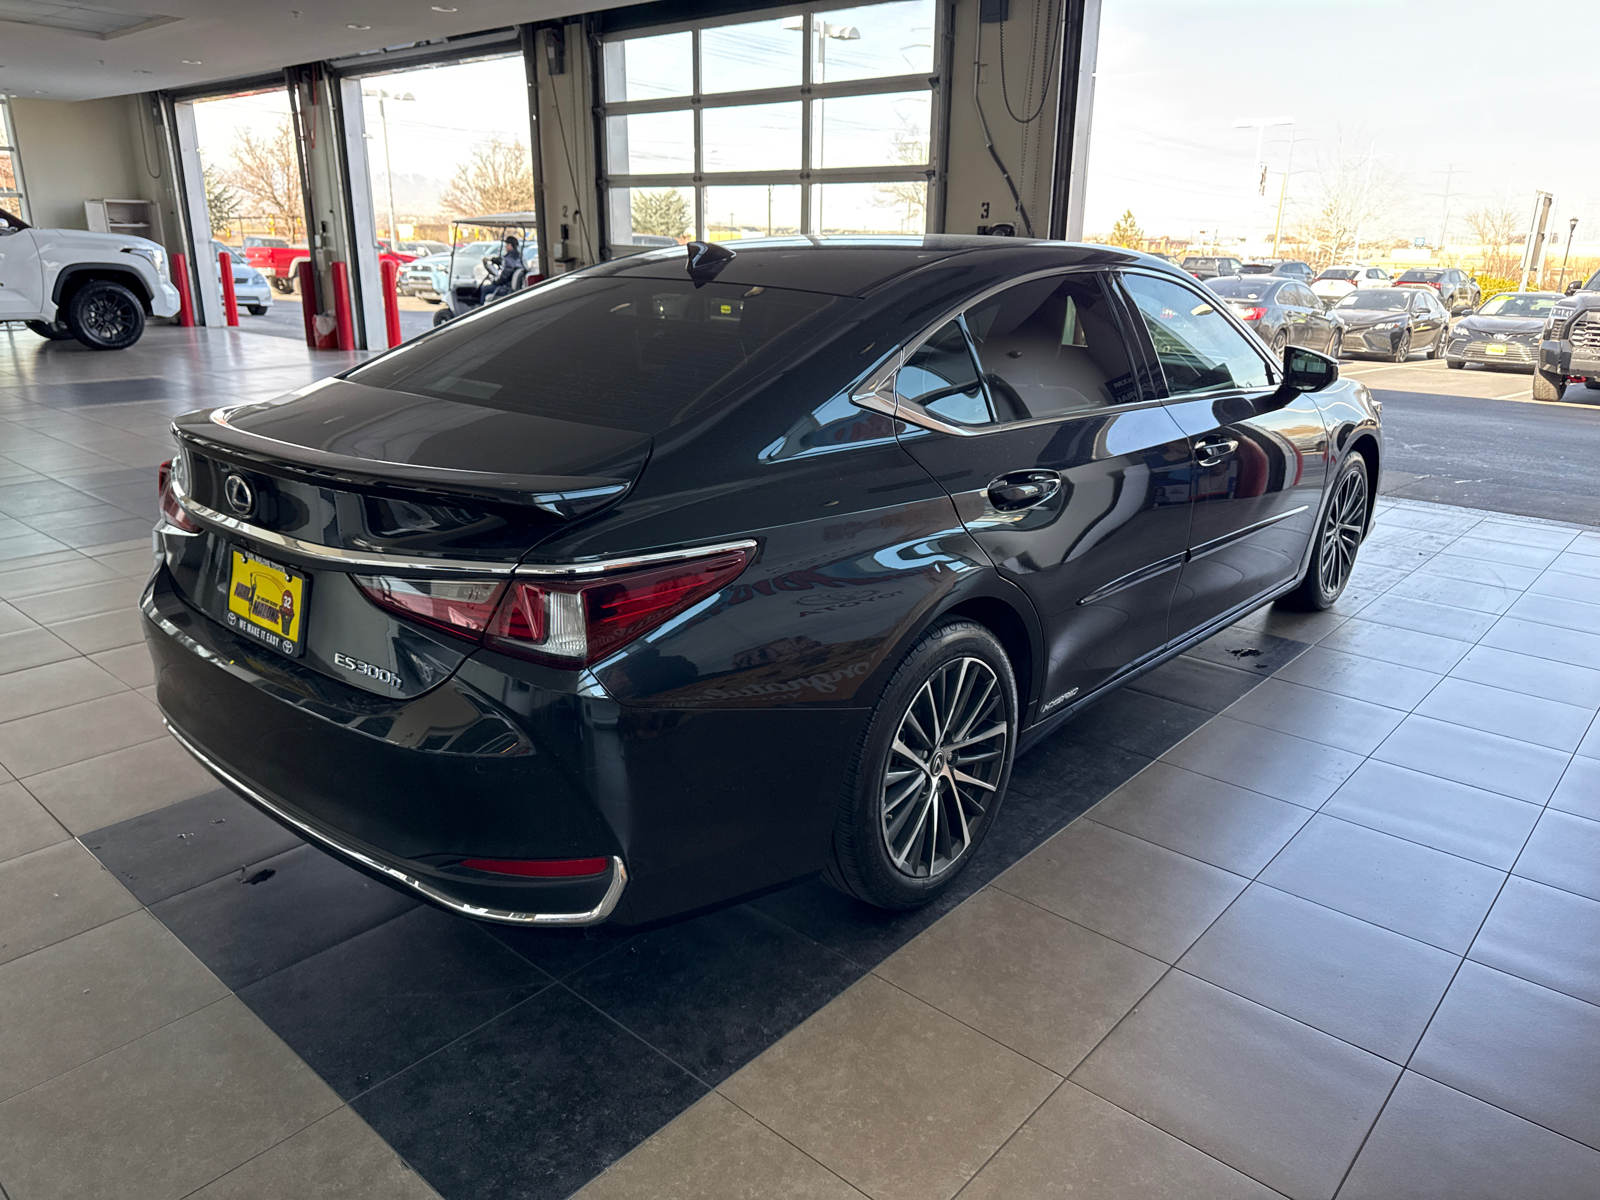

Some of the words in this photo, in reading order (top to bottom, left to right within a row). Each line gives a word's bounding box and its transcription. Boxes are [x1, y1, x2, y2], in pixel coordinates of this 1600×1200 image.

[562, 205, 569, 218] 2
[980, 201, 990, 219] 3
[283, 595, 292, 609] 32
[239, 618, 247, 631] WE
[247, 622, 261, 638] MAKE
[260, 629, 266, 640] IT
[266, 632, 280, 647] EASY
[334, 652, 402, 689] ES300h
